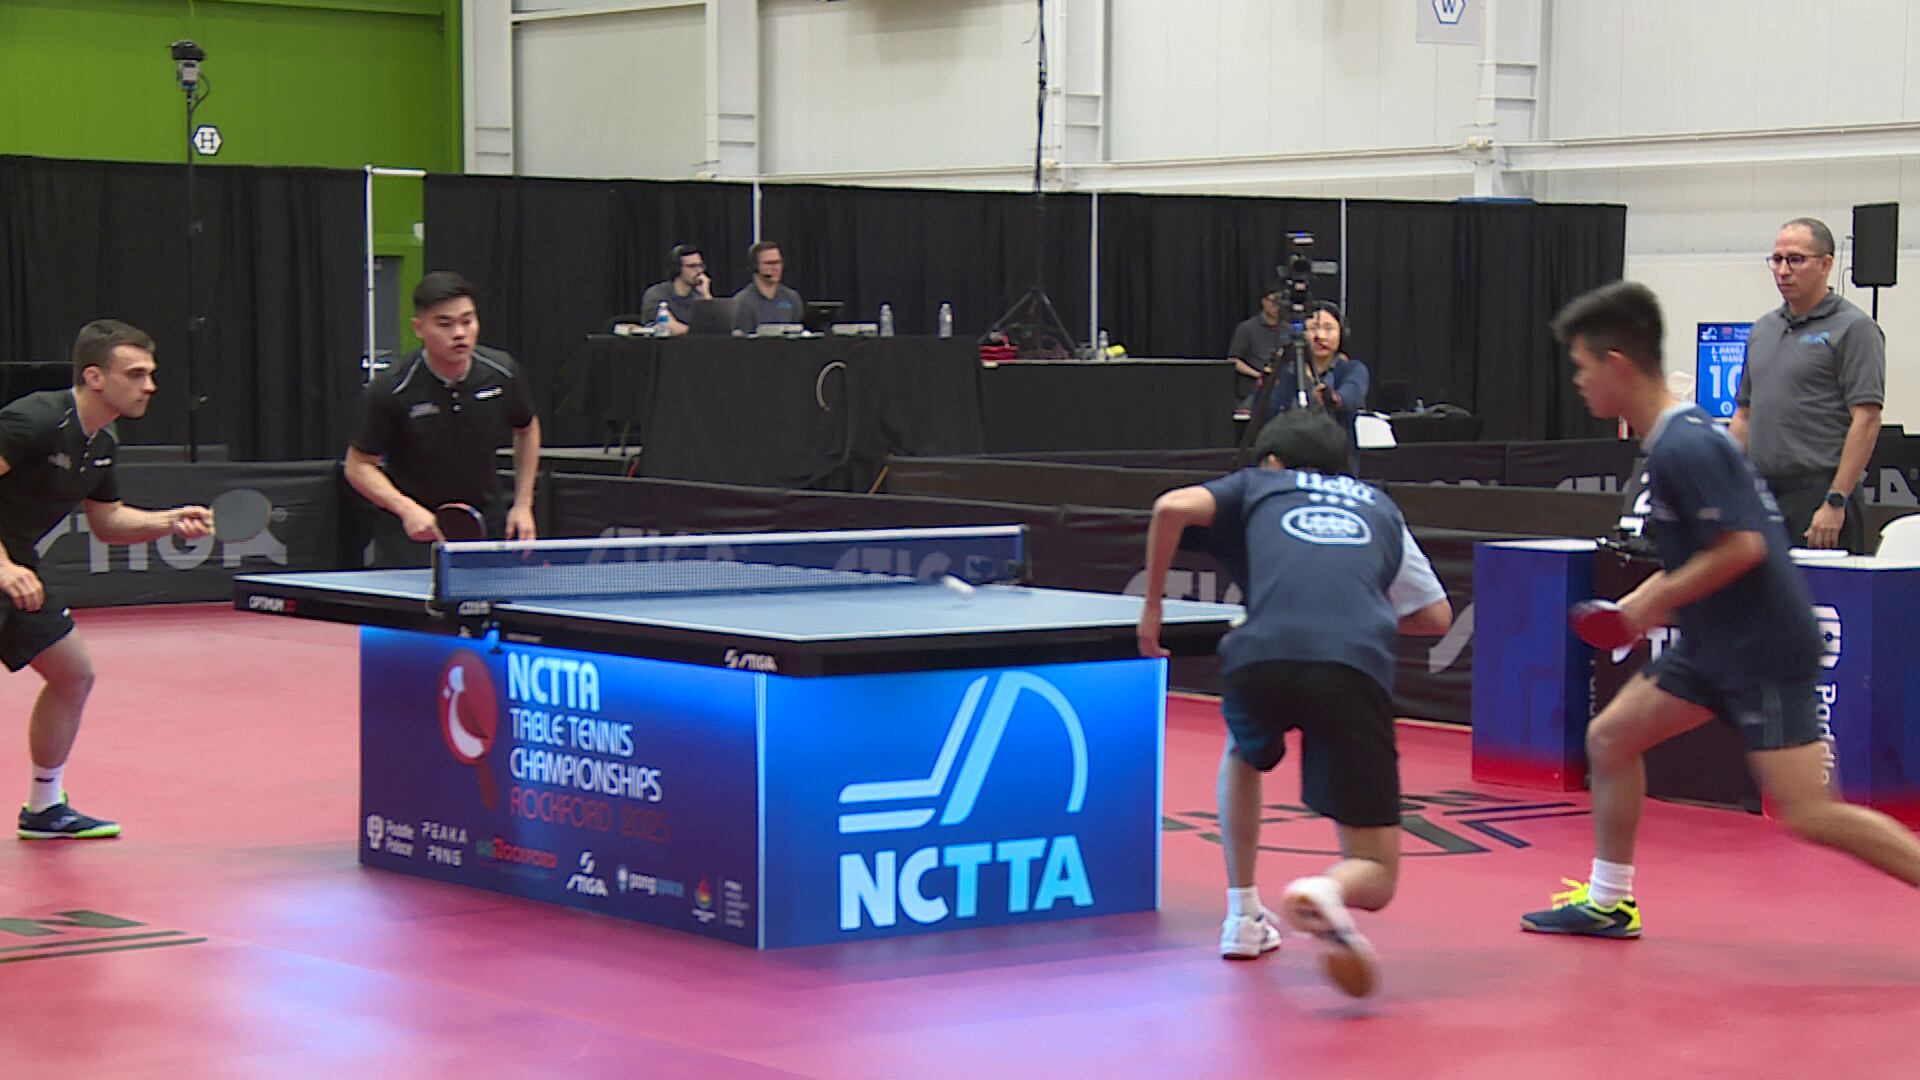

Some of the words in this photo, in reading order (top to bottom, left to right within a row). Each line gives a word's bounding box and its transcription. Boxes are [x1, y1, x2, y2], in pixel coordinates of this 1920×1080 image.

[200, 131, 215, 149] H
[507, 651, 601, 712] NCTTA
[509, 707, 566, 747] TABLE
[567, 715, 635, 758] TENNIS
[510, 747, 663, 802] CHAMPIONSHIPS
[511, 786, 613, 833] ROCKFORD
[566, 873, 609, 897] STIGA
[840, 835, 1094, 930] NCTTA
